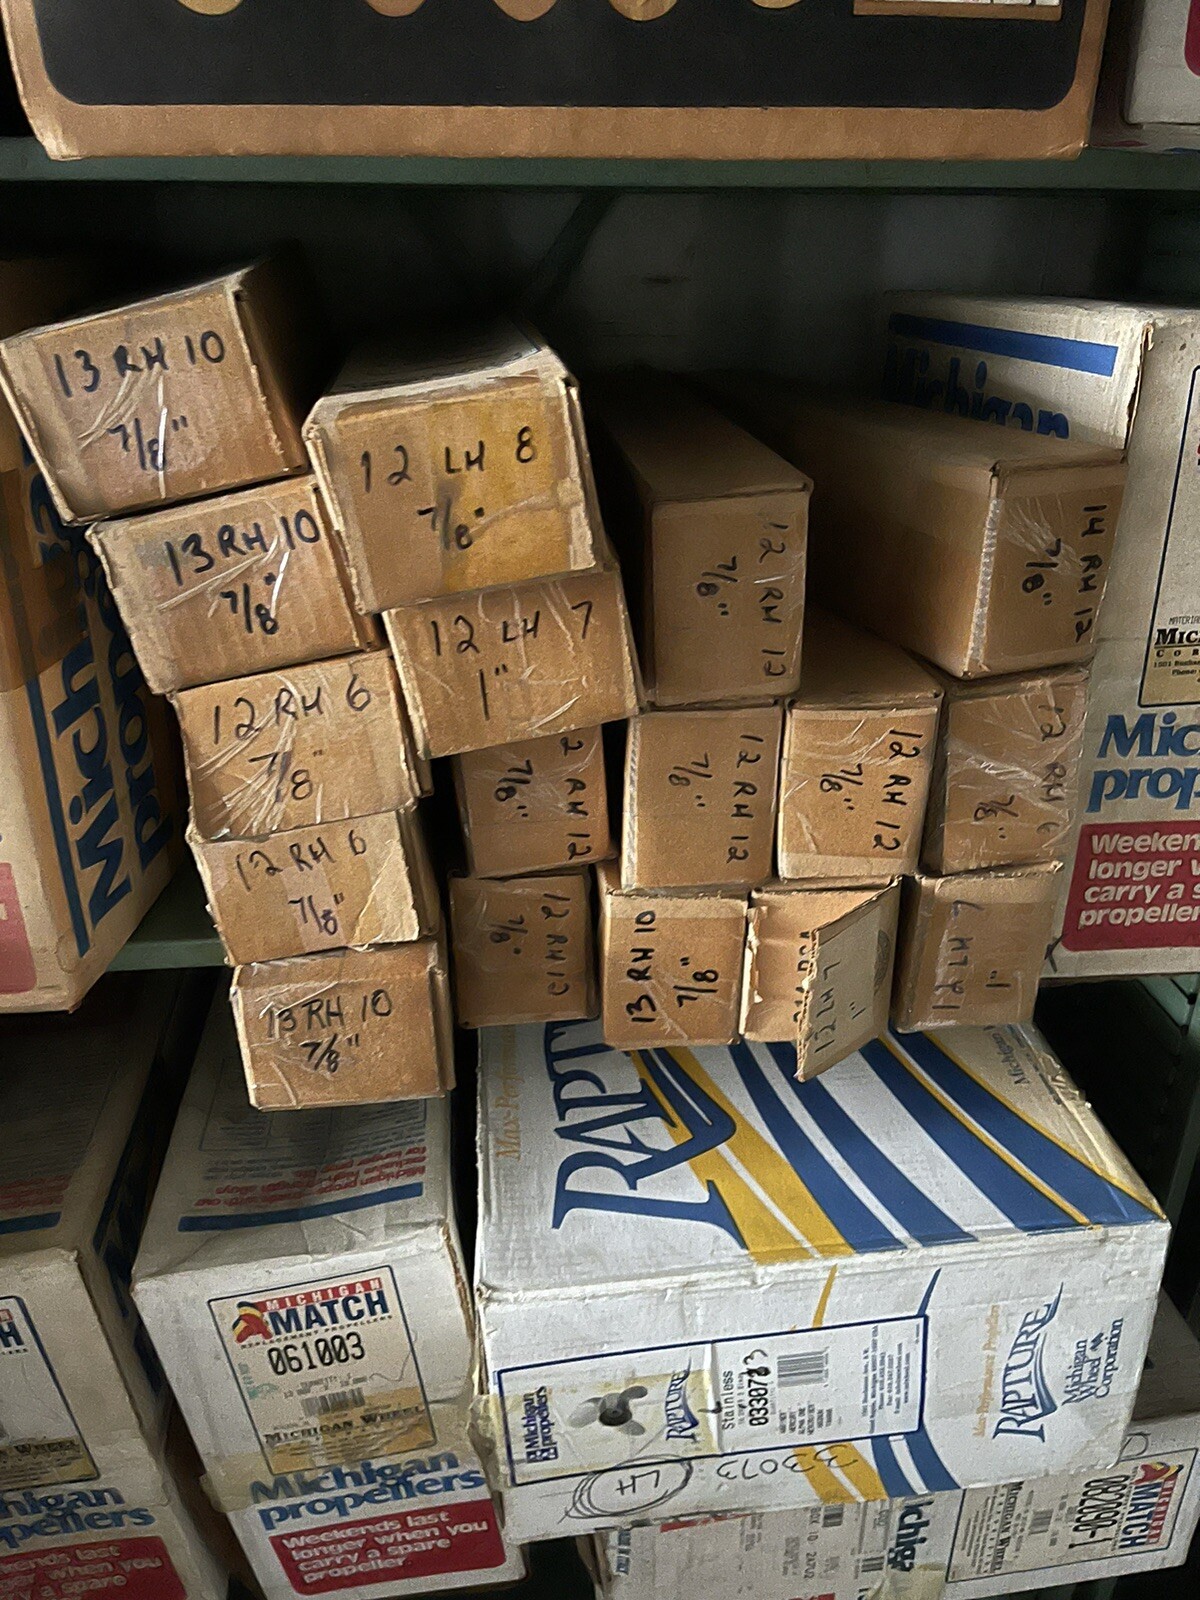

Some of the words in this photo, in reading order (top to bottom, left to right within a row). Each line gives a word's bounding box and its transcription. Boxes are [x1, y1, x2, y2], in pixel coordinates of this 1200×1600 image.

[53, 349, 100, 398] 13
[113, 337, 168, 377] RH
[185, 330, 225, 364] 10
[360, 444, 413, 494] 12
[444, 439, 487, 474] LH
[515, 425, 538, 464] 8
[164, 532, 215, 587] 13
[217, 520, 267, 559] RH
[279, 508, 321, 551] 10
[759, 521, 790, 564] 12
[695, 554, 739, 617] 7/8"
[1077, 554, 1105, 594] RH
[430, 614, 480, 657] 12
[501, 610, 541, 643] LH
[570, 600, 594, 640] 7
[1073, 607, 1094, 644] 12
[1154, 627, 1200, 646] MIC
[212, 696, 262, 746] 12
[273, 686, 325, 727] RH
[345, 672, 372, 713] 6
[476, 663, 509, 722] 1"
[888, 728, 924, 760] 12
[1037, 703, 1068, 743] 12
[735, 733, 765, 769] 12
[667, 751, 714, 808] 7/8"
[730, 779, 758, 820] RH
[818, 762, 865, 811] 7/8"
[881, 773, 912, 807] RH
[565, 831, 593, 861] 12
[725, 834, 750, 865] 12
[872, 819, 902, 852] 12
[235, 850, 284, 893] 12
[288, 835, 337, 873] RH
[348, 828, 368, 857] 6
[1088, 858, 1183, 883] longer
[540, 892, 572, 921] 12
[1083, 882, 1161, 905] carry
[1166, 883, 1185, 900] a
[633, 909, 657, 934] 10
[545, 933, 569, 962] RH
[626, 947, 656, 982] RH
[672, 956, 720, 1008] 7/8"
[266, 1003, 298, 1039] 13
[301, 996, 346, 1031] RH
[360, 987, 394, 1023] 10
[625, 993, 657, 1024] 13
[300, 1033, 361, 1075] 7/8"
[265, 1278, 382, 1311] MICHIGAN
[268, 1289, 390, 1336] MATCH
[266, 1331, 366, 1376] 061003
[993, 1293, 1058, 1443] RAPTURE
[1061, 1338, 1088, 1406] Michigan
[1094, 1317, 1124, 1400] Corporation
[721, 1369, 736, 1431] Stainless
[1075, 1356, 1101, 1403] Wheel
[522, 1392, 540, 1450] Michigan
[536, 1385, 557, 1449] propellers
[665, 1362, 699, 1444] RAPTURE
[250, 1451, 460, 1504] Michigan
[614, 1469, 661, 1496] LH
[257, 1469, 487, 1531] propellers
[1117, 1481, 1163, 1550] MATCH
[281, 1518, 402, 1549] Weekends
[405, 1510, 451, 1528] last
[291, 1537, 367, 1561] longer
[374, 1527, 440, 1546] when
[446, 1519, 489, 1536] you
[297, 1551, 360, 1572] carry
[366, 1548, 381, 1559] a
[386, 1536, 451, 1556] spare
